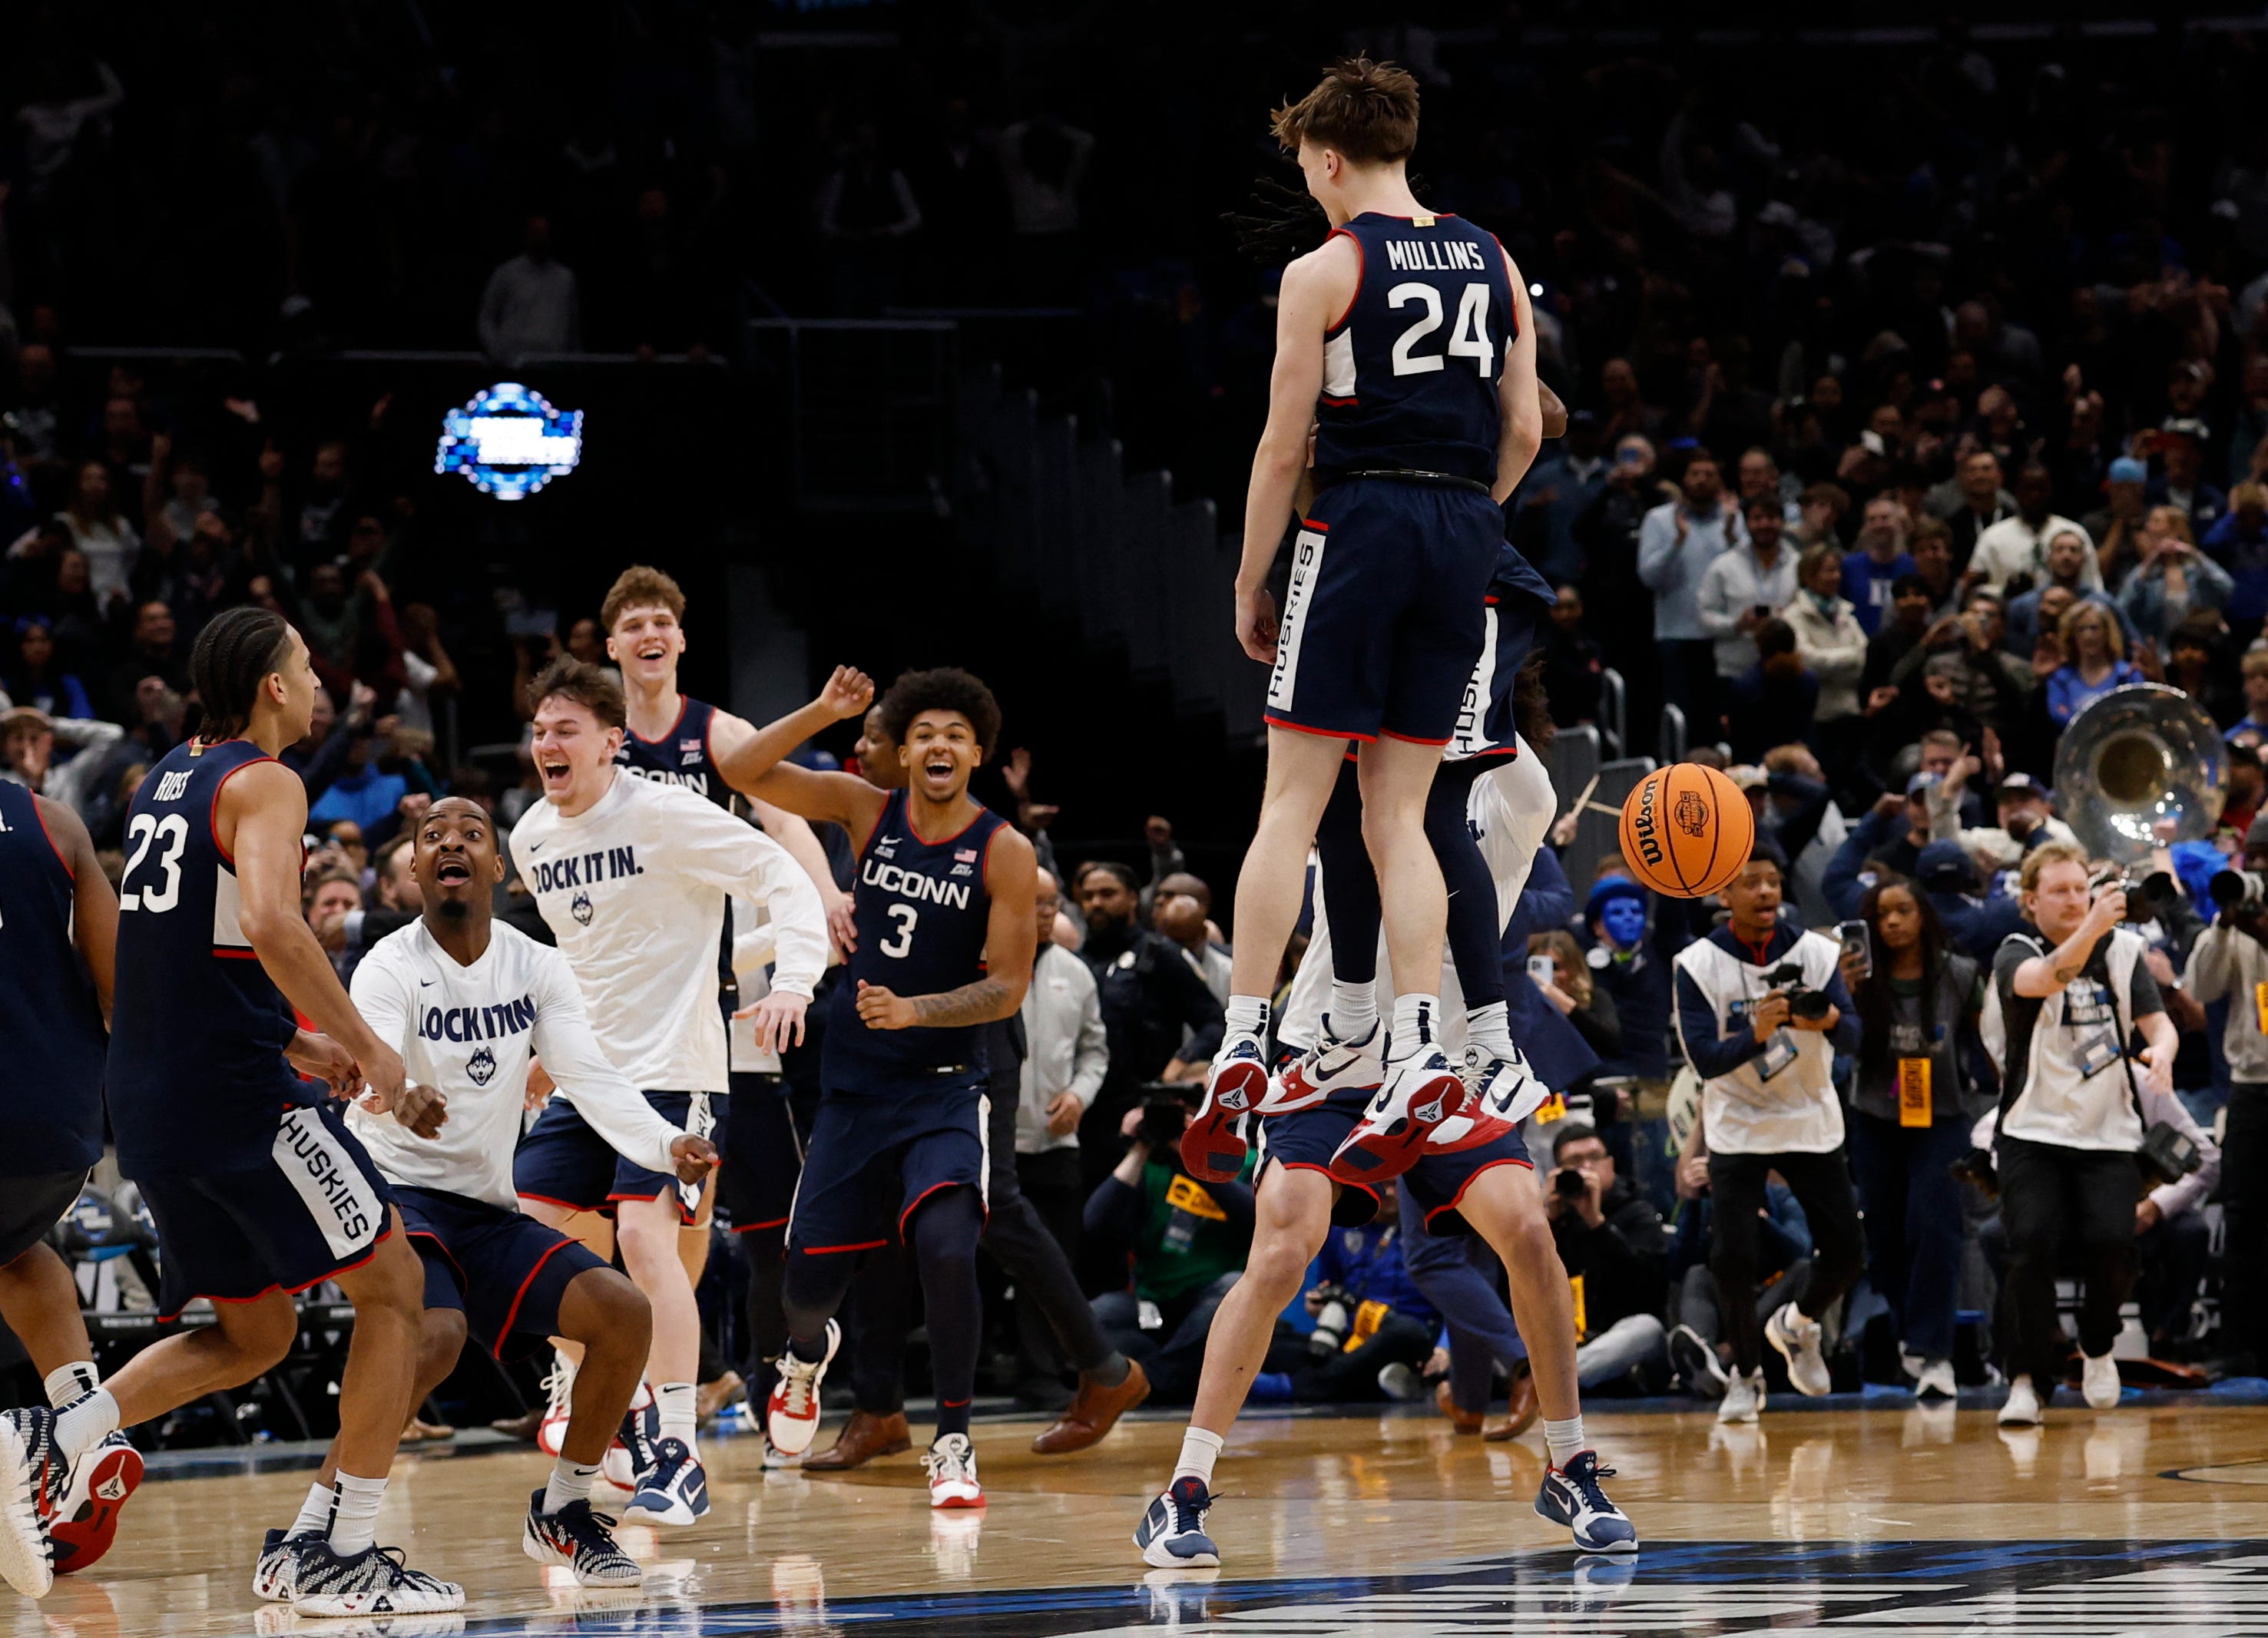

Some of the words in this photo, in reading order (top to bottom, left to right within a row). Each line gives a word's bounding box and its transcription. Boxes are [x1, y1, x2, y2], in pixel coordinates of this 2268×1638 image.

[1386, 240, 1485, 270] MULLINS
[1387, 282, 1495, 378] 24
[1269, 543, 1314, 697] HUSKIES
[153, 769, 194, 801] ROSS
[1635, 778, 1664, 867] Wilson
[119, 813, 189, 913] 23
[584, 852, 604, 884] IT
[608, 845, 644, 880] IN.
[862, 859, 971, 911] UCONN
[879, 903, 918, 958] 3
[418, 1004, 483, 1042] LOCK
[280, 1114, 369, 1241] HUSKIES
